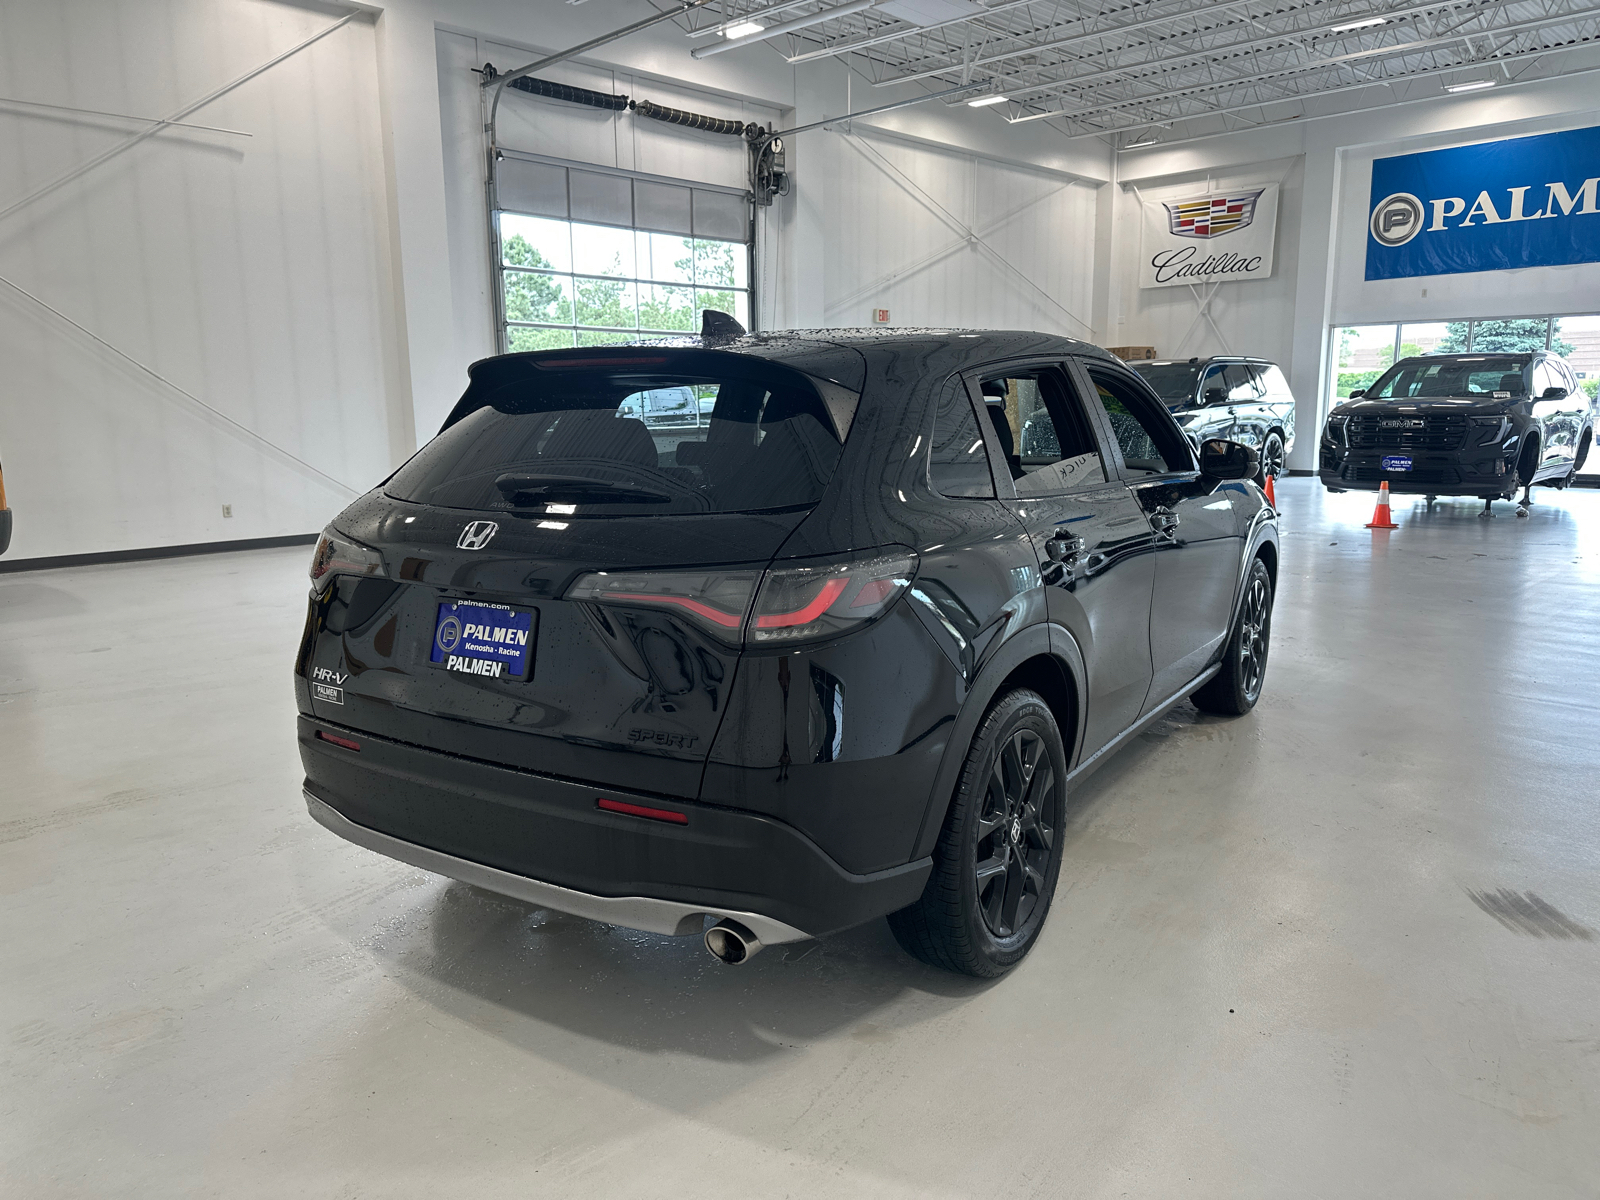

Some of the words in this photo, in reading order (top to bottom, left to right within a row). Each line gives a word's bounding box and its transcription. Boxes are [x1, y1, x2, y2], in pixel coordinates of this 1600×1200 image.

[1151, 246, 1262, 283] Cadillac
[1381, 420, 1424, 428] GMC
[489, 501, 515, 509] AWD
[457, 600, 511, 611] palmen.com
[462, 623, 529, 646] PALMEN
[465, 642, 494, 653] Kenosha
[498, 646, 521, 657] Racine
[446, 654, 503, 678] PALMEN
[313, 666, 348, 685] HR-V
[317, 685, 338, 698] PALMEN
[626, 728, 699, 750] SPORT
